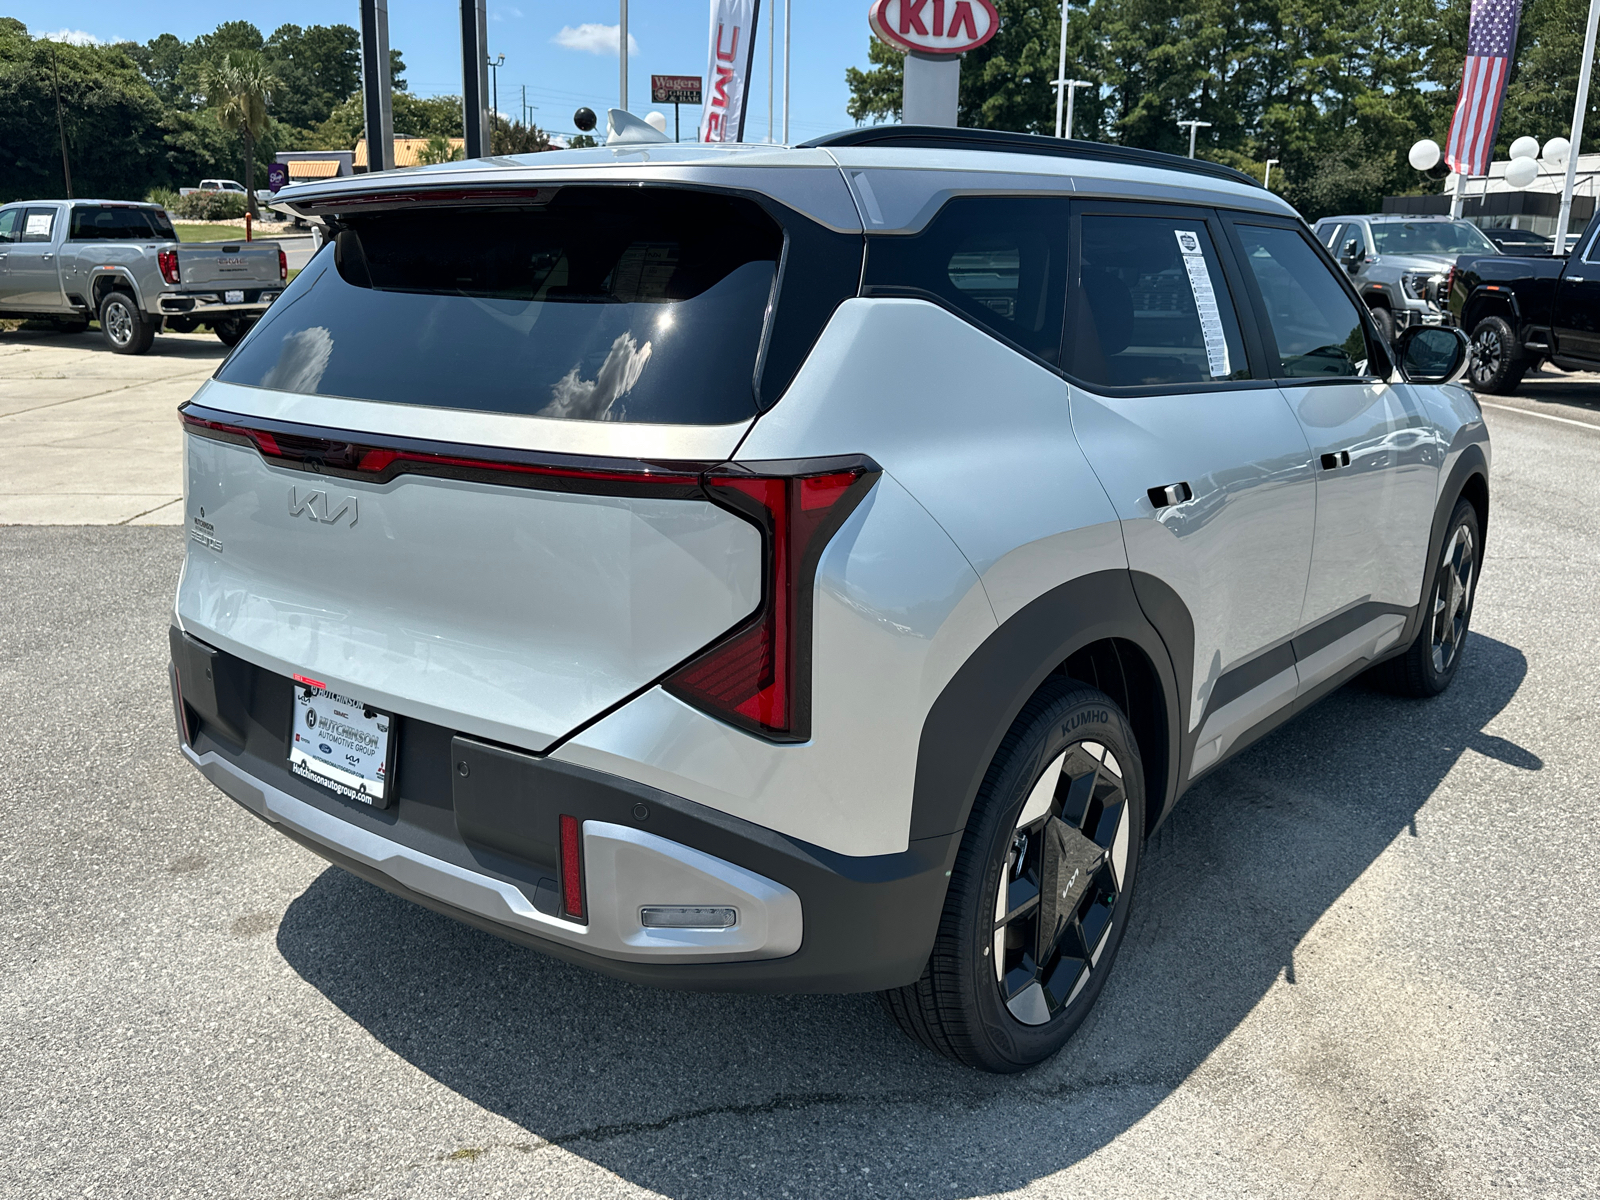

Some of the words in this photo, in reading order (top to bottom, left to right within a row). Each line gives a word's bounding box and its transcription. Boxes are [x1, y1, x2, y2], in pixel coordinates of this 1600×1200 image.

[899, 0, 978, 39] KIA
[654, 76, 700, 90] Wagers
[705, 23, 740, 142] GMC
[217, 257, 248, 266] GMC
[288, 485, 358, 528] KIA
[334, 709, 348, 719] GMC
[1061, 710, 1108, 737] KUMHO
[318, 716, 379, 748] HUTCHINSON
[318, 730, 354, 750] AUTOMOTIVE
[356, 744, 375, 756] GROUP
[292, 763, 373, 805] Hutchinsonautogroup.com
